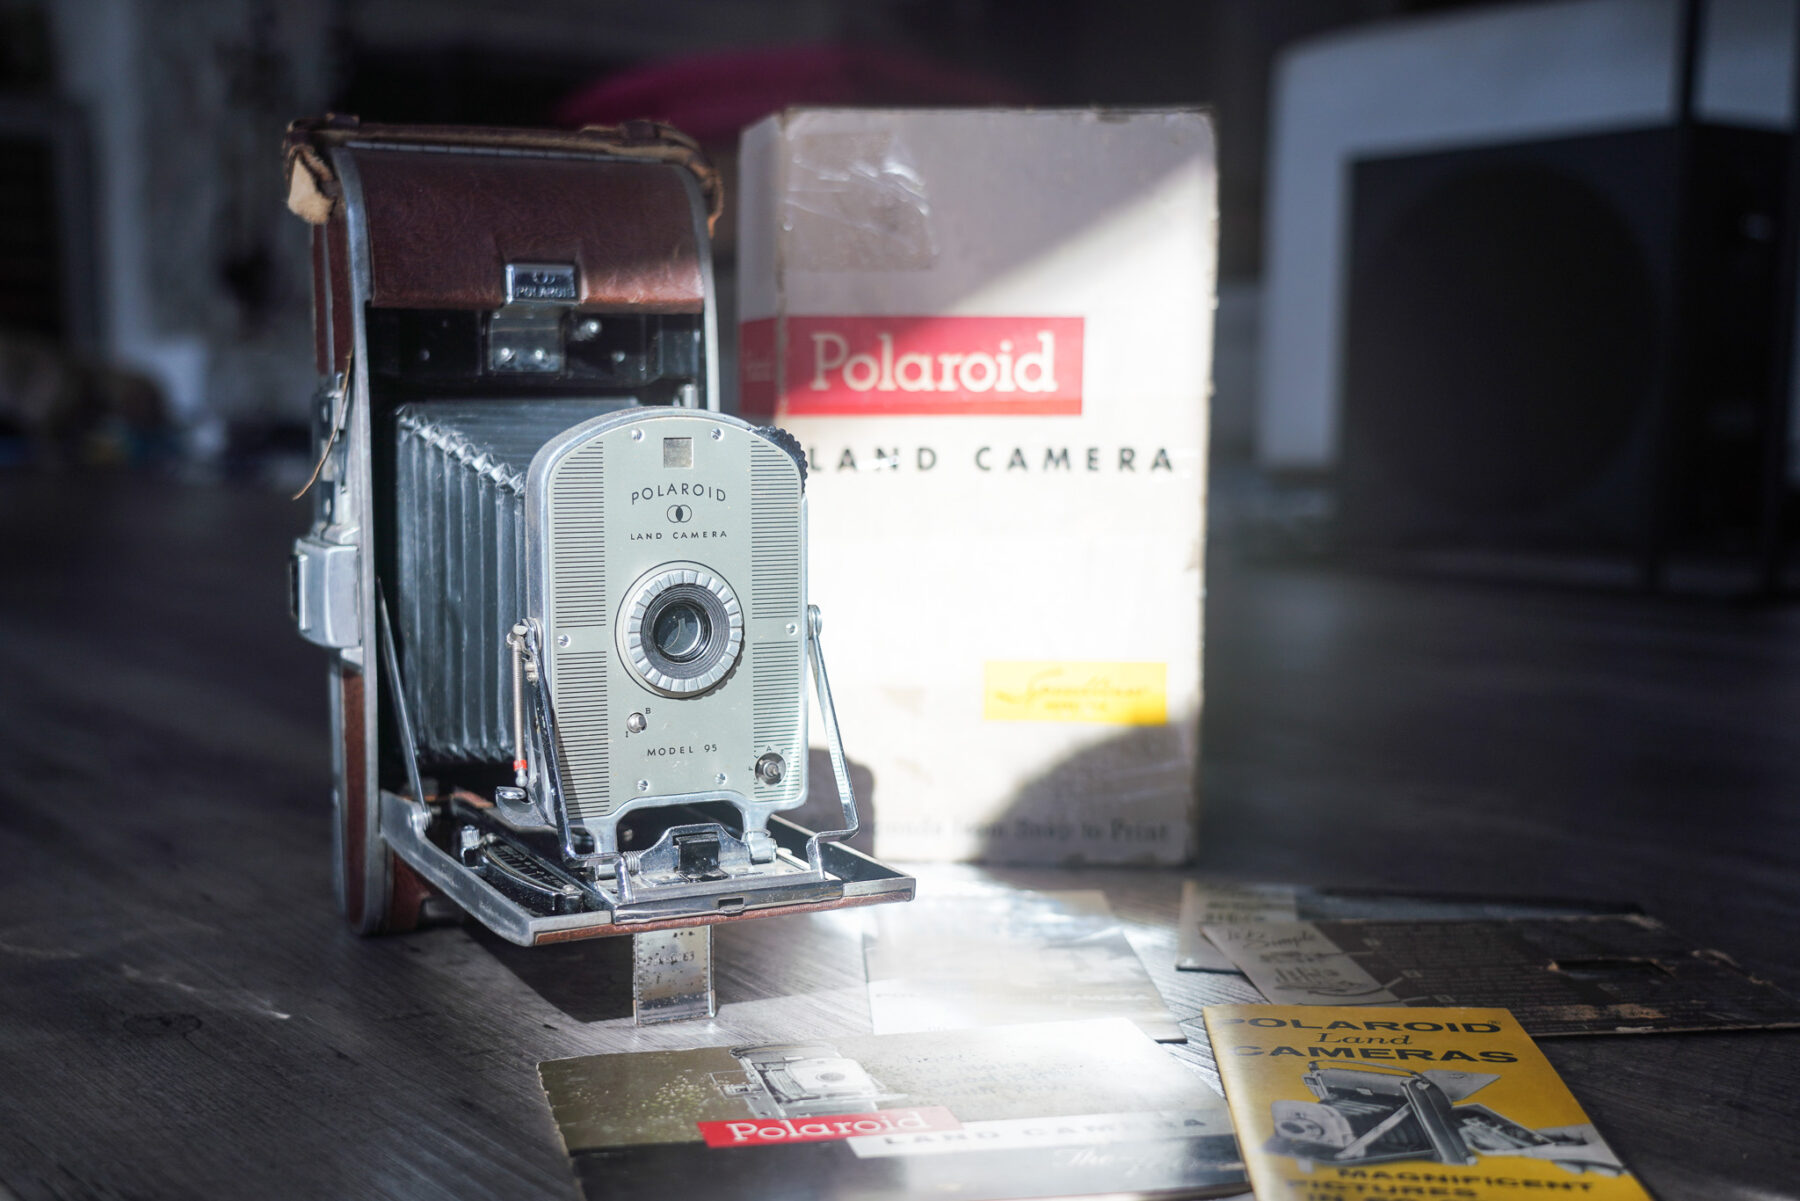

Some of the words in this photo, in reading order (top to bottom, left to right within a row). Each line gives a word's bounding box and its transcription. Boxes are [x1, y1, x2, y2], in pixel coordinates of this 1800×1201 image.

[809, 329, 1058, 393] Polaroid
[809, 447, 937, 472] LAND
[975, 446, 1172, 472] CAMERA
[631, 482, 726, 505] POLAROID
[630, 531, 663, 541] LAND
[672, 530, 728, 540] CAMERA
[645, 707, 652, 715] B
[647, 745, 694, 757] MODEL
[703, 743, 718, 753] 95
[1314, 1032, 1413, 1046] Land
[1230, 1045, 1518, 1063] CAMERAS
[726, 1111, 933, 1143] Polaroid
[1336, 1168, 1595, 1193] MAGNIFICENT
